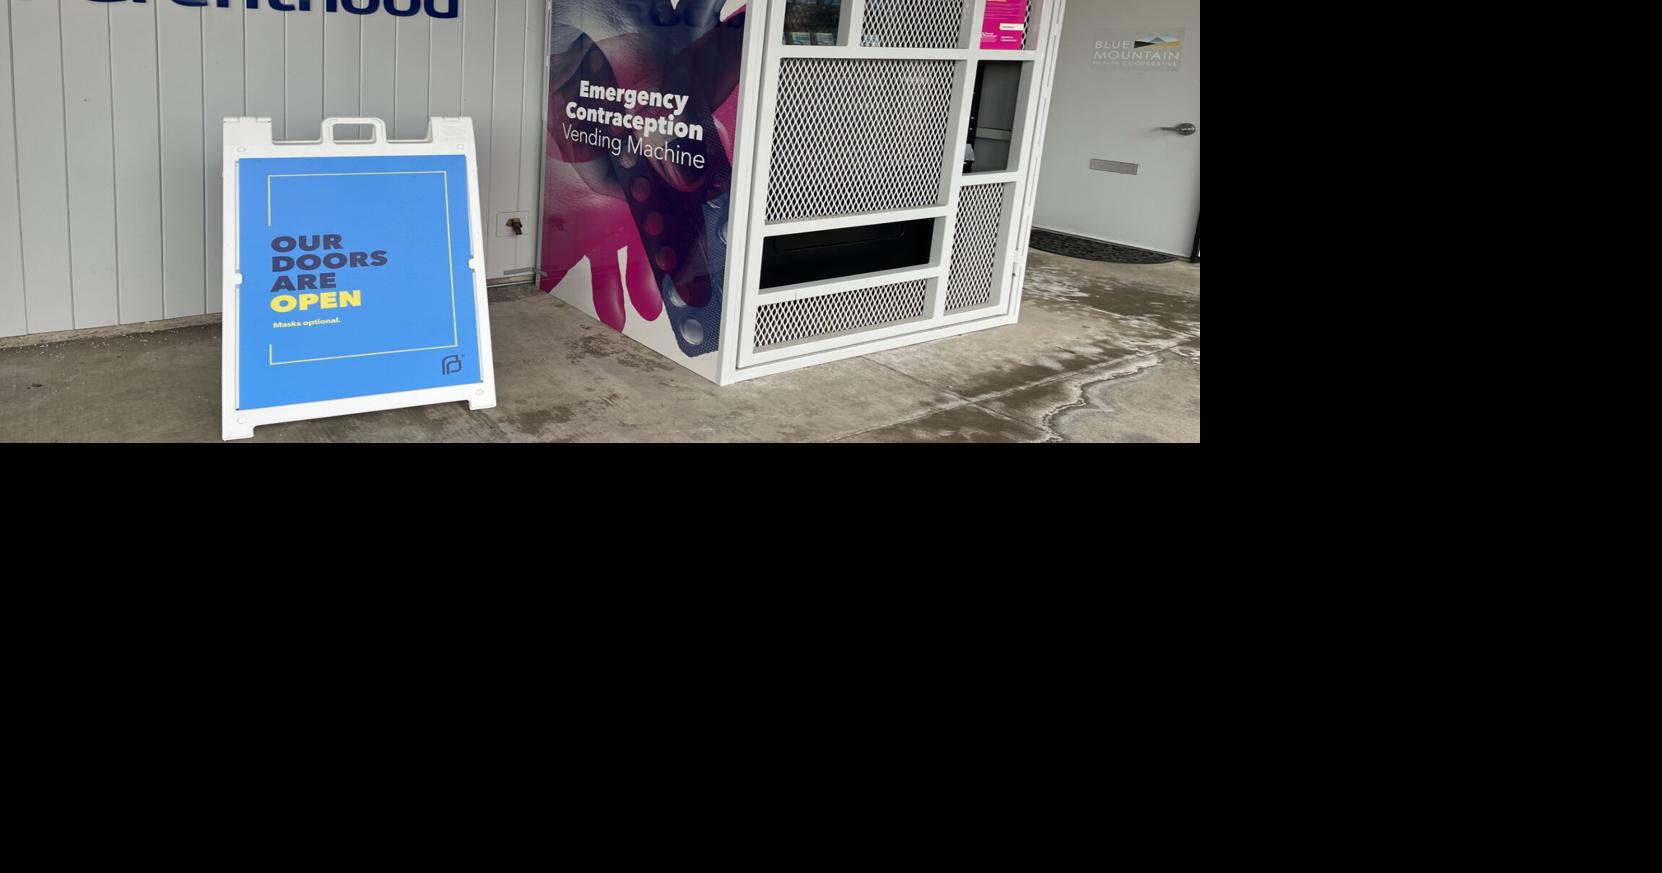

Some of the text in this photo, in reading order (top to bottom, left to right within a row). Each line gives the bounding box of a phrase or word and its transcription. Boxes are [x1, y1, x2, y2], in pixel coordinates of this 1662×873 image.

[1095, 40, 1131, 49] BLUE
[1093, 51, 1180, 60] MOUNTAIN
[579, 80, 689, 116] Emergency
[566, 101, 704, 141] Contraception
[562, 122, 705, 169] Vending Machine
[271, 234, 343, 253] OUR
[272, 250, 388, 272] DOORS
[270, 272, 336, 292] ARE
[270, 290, 361, 313] OPEN
[273, 317, 341, 328] Masks optional.
